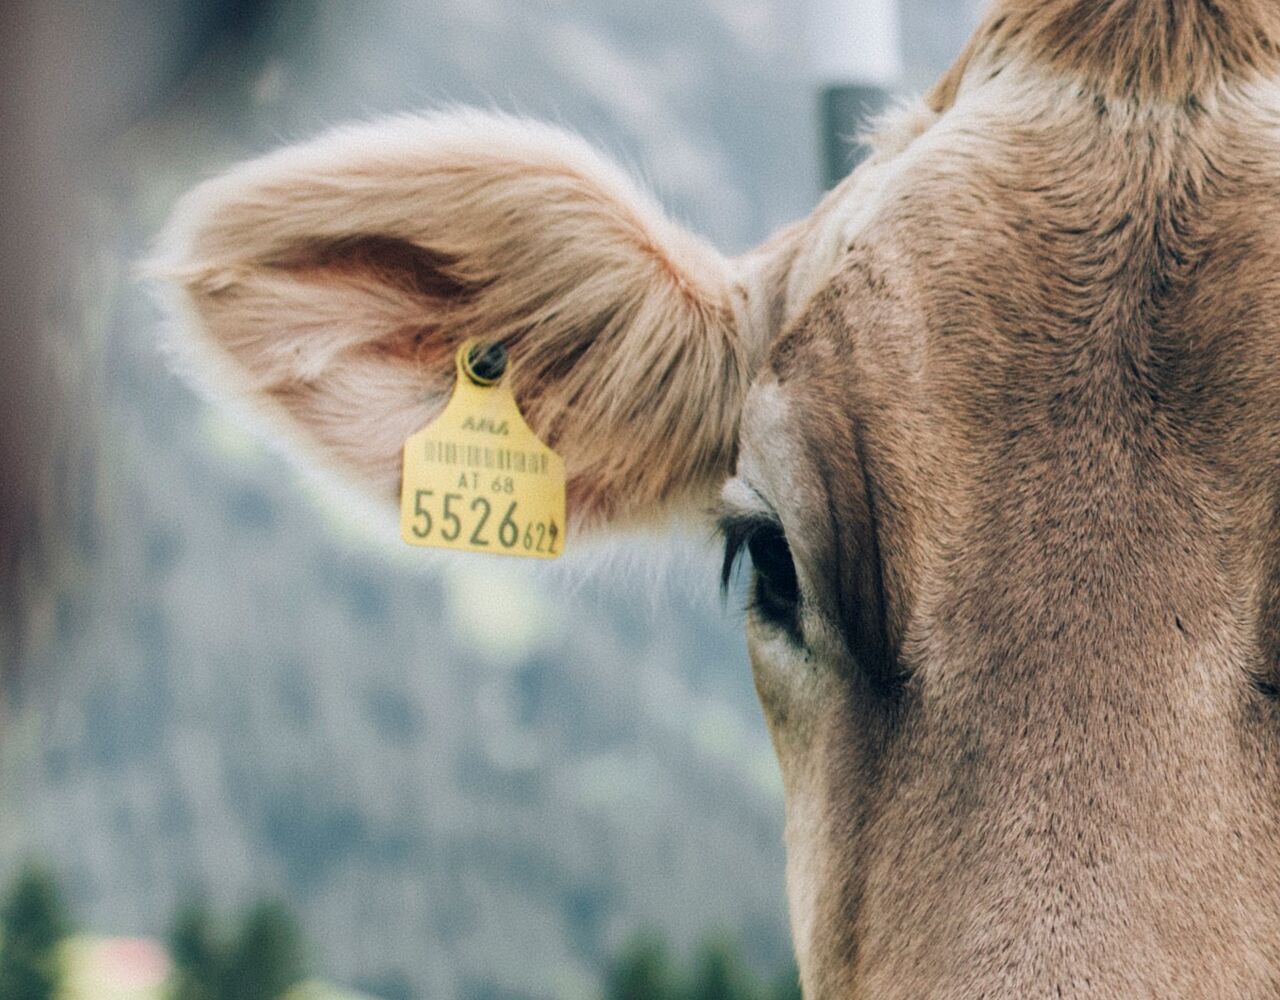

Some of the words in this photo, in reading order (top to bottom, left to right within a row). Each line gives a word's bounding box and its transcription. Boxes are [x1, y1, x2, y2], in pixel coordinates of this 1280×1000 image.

[458, 472, 480, 489] AT
[491, 476, 515, 494] 68
[412, 489, 519, 548] 5526
